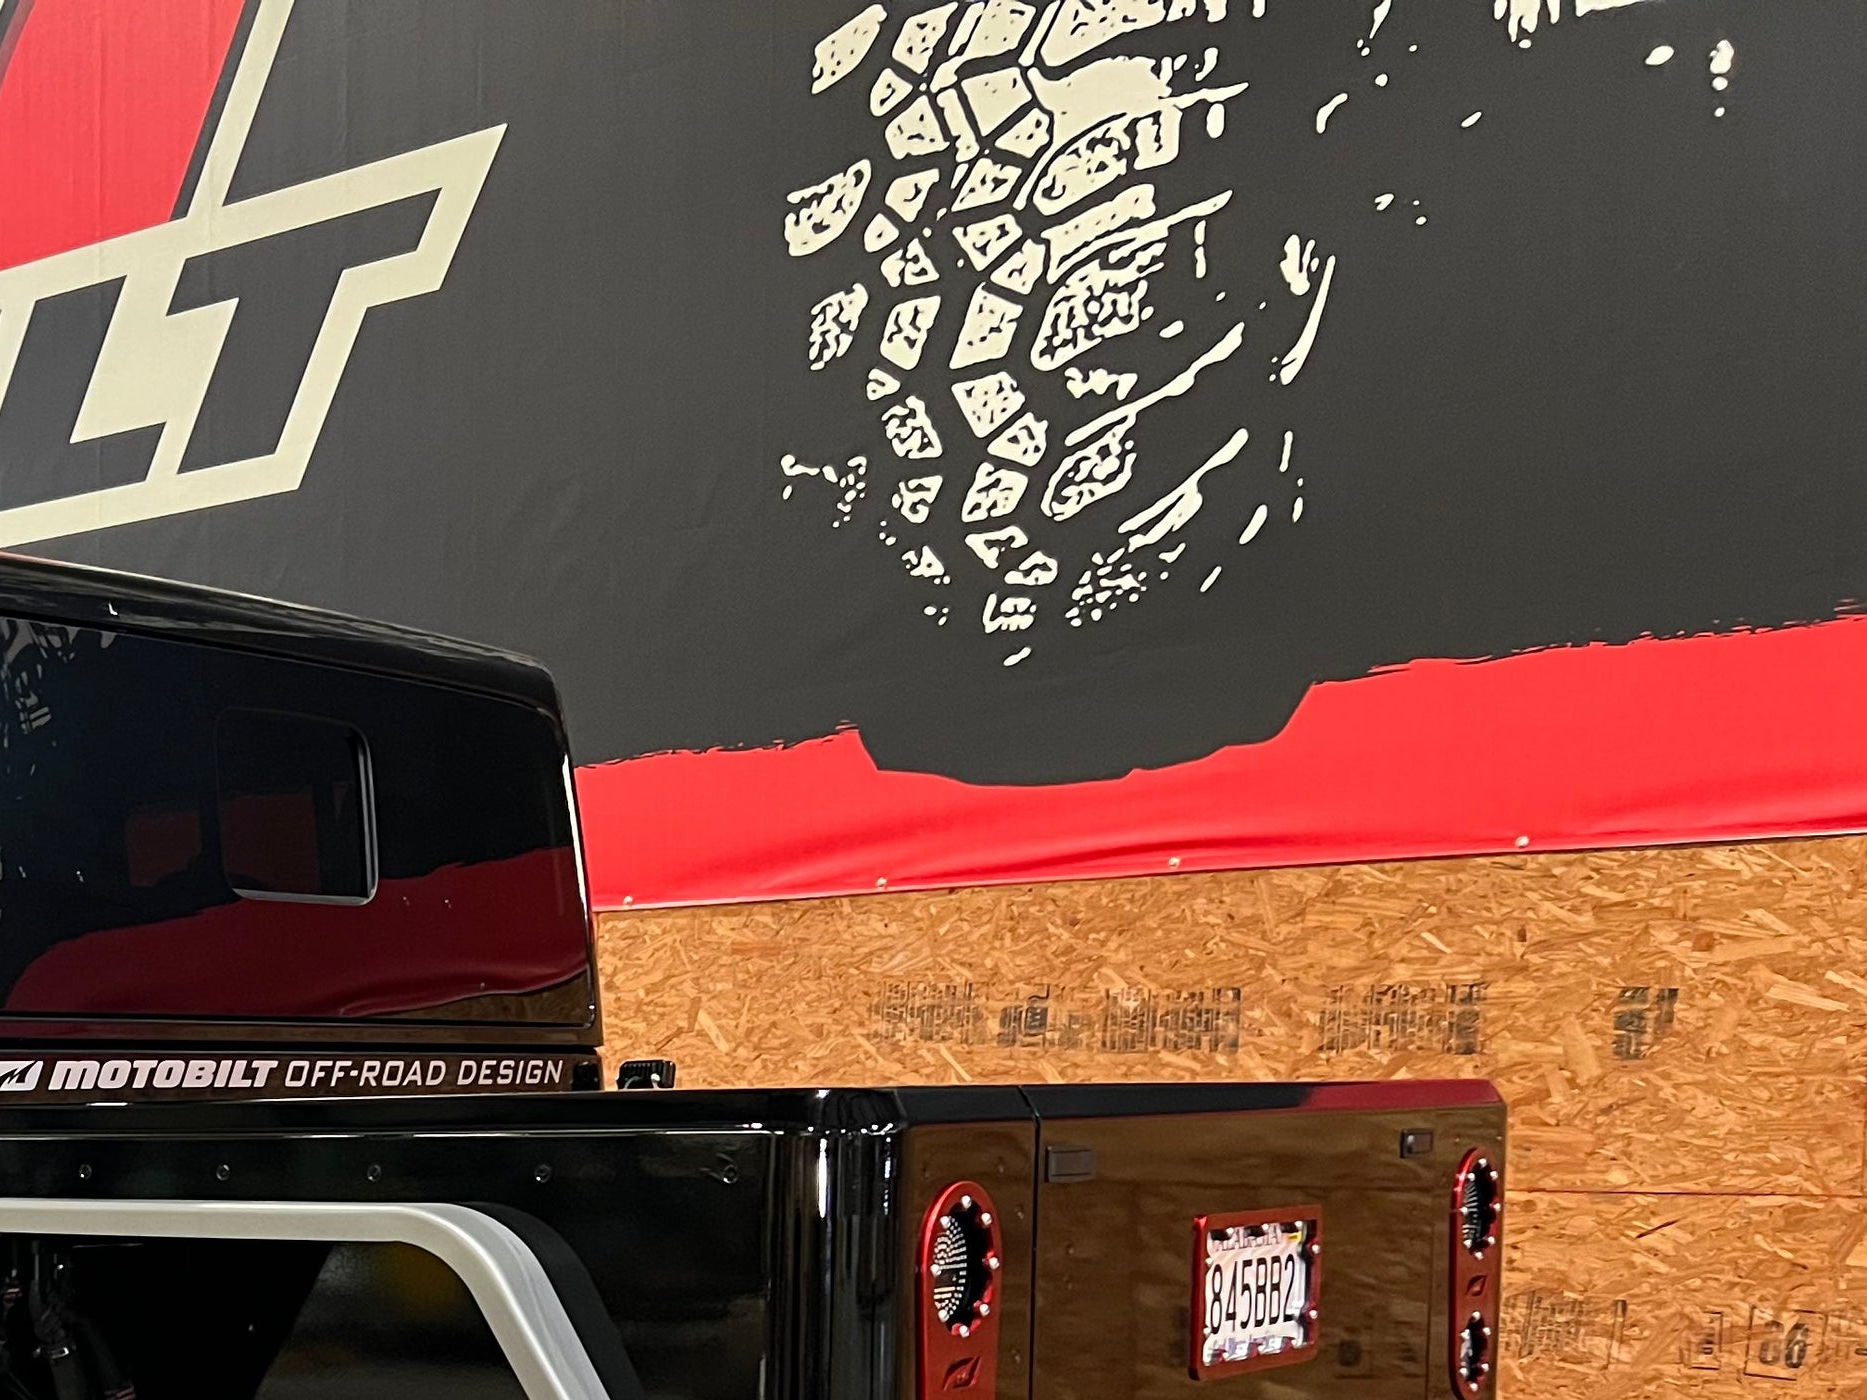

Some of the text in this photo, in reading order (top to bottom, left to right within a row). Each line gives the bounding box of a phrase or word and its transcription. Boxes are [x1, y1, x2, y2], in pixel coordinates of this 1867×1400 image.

[48, 1058, 565, 1091] MOTOBILT OFF-ROAD DESIGN
[1210, 1253, 1296, 1335] 845BB2
